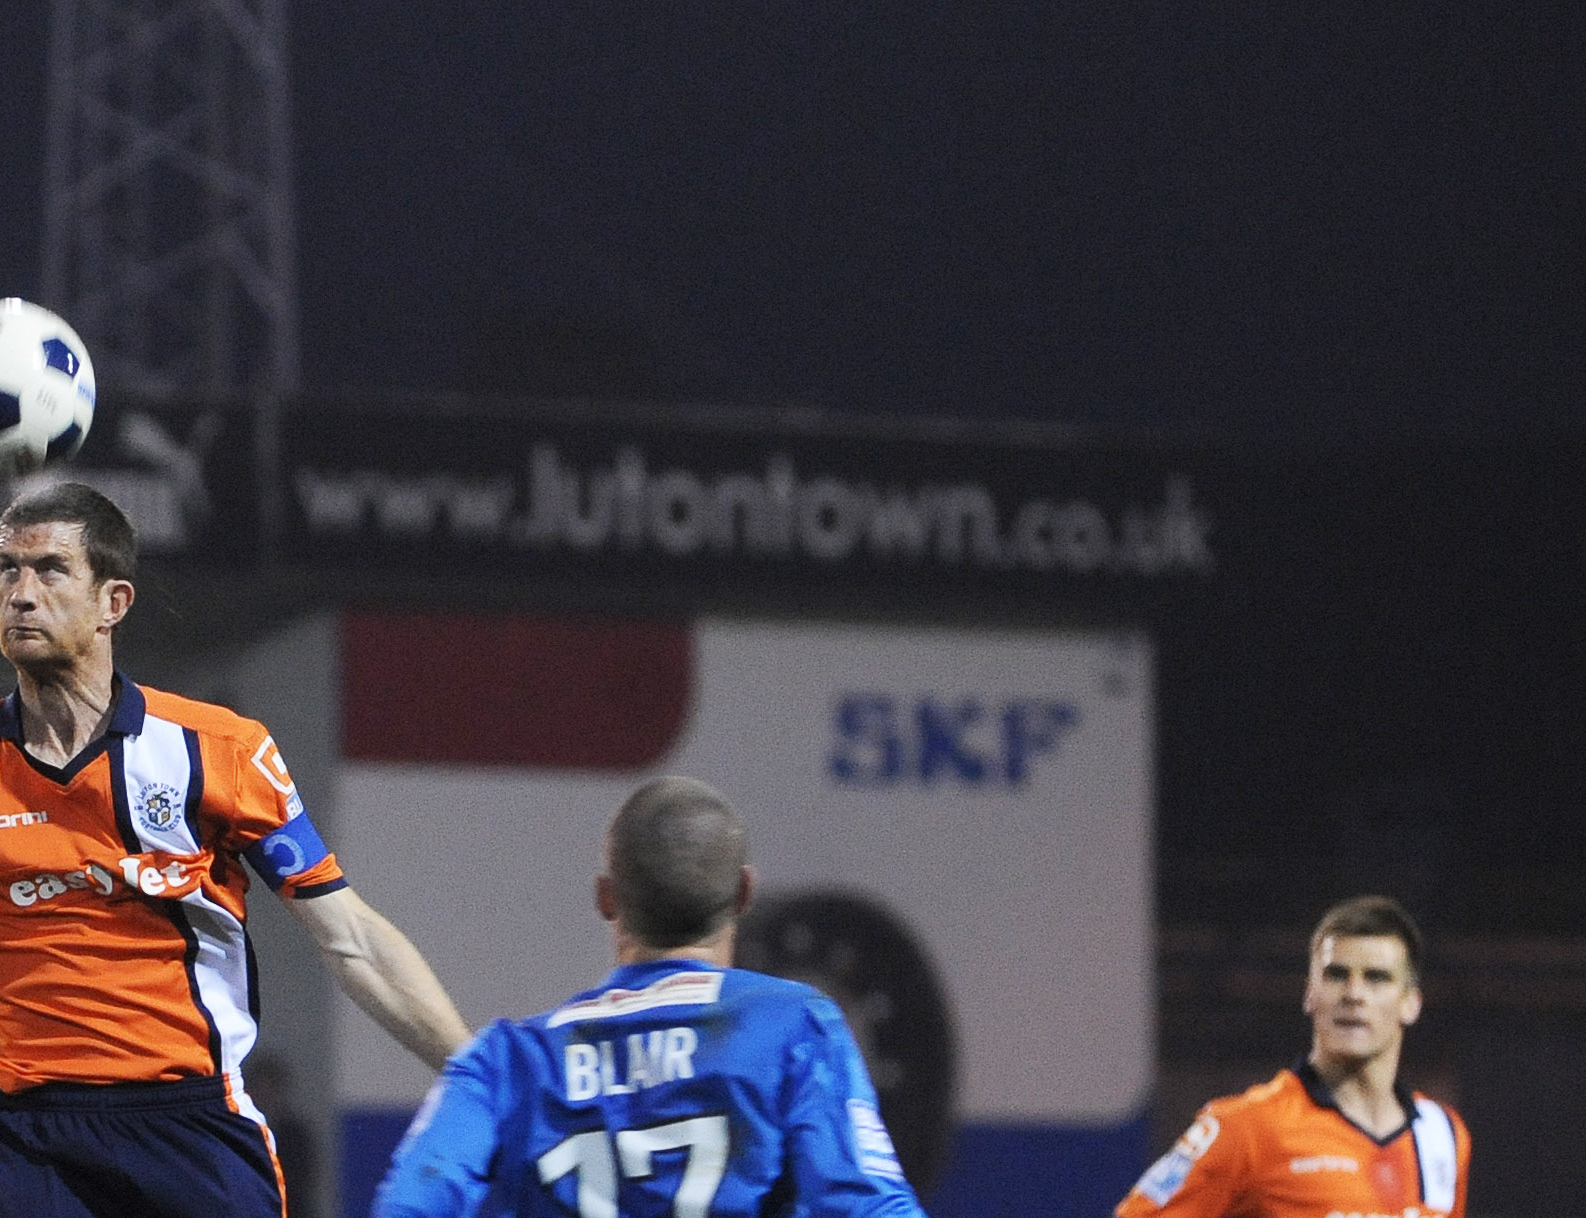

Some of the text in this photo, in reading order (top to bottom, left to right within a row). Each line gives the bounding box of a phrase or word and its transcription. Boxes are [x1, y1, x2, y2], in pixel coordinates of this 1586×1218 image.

[296, 443, 1213, 570] www.lutontown.co.uk
[830, 691, 1079, 787] SKF
[564, 1026, 698, 1101] BLAIR
